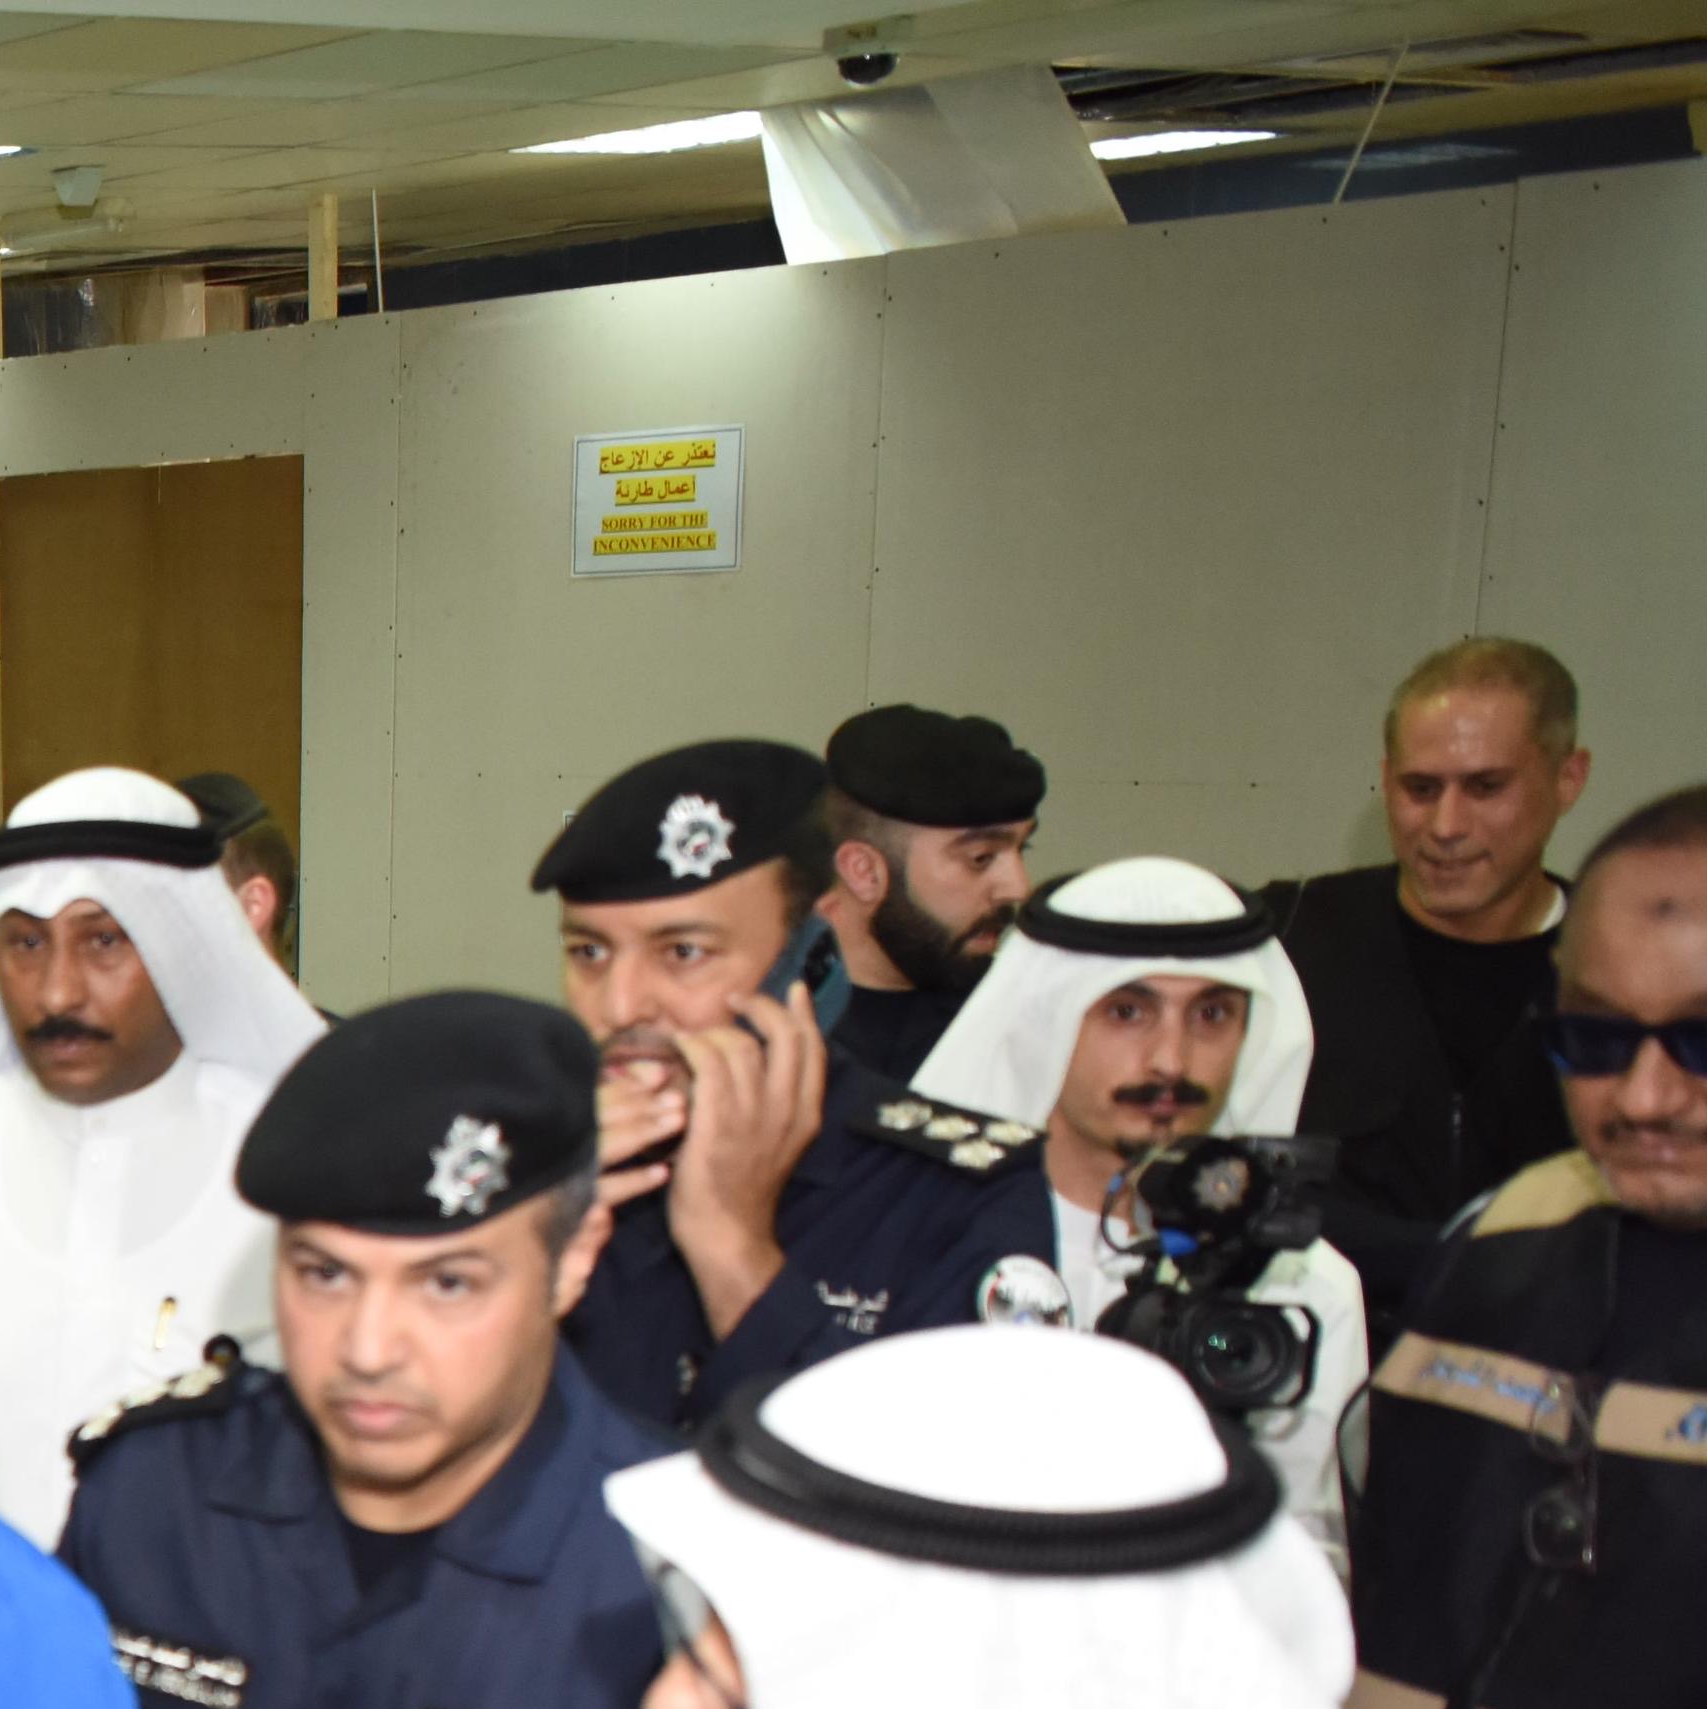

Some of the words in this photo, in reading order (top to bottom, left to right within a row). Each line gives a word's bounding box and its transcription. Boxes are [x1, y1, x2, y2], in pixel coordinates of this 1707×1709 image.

[602, 515, 645, 530] SORRY
[650, 514, 677, 528] FOR
[682, 511, 708, 527] THE
[593, 534, 716, 553] INCONVENIENCE
